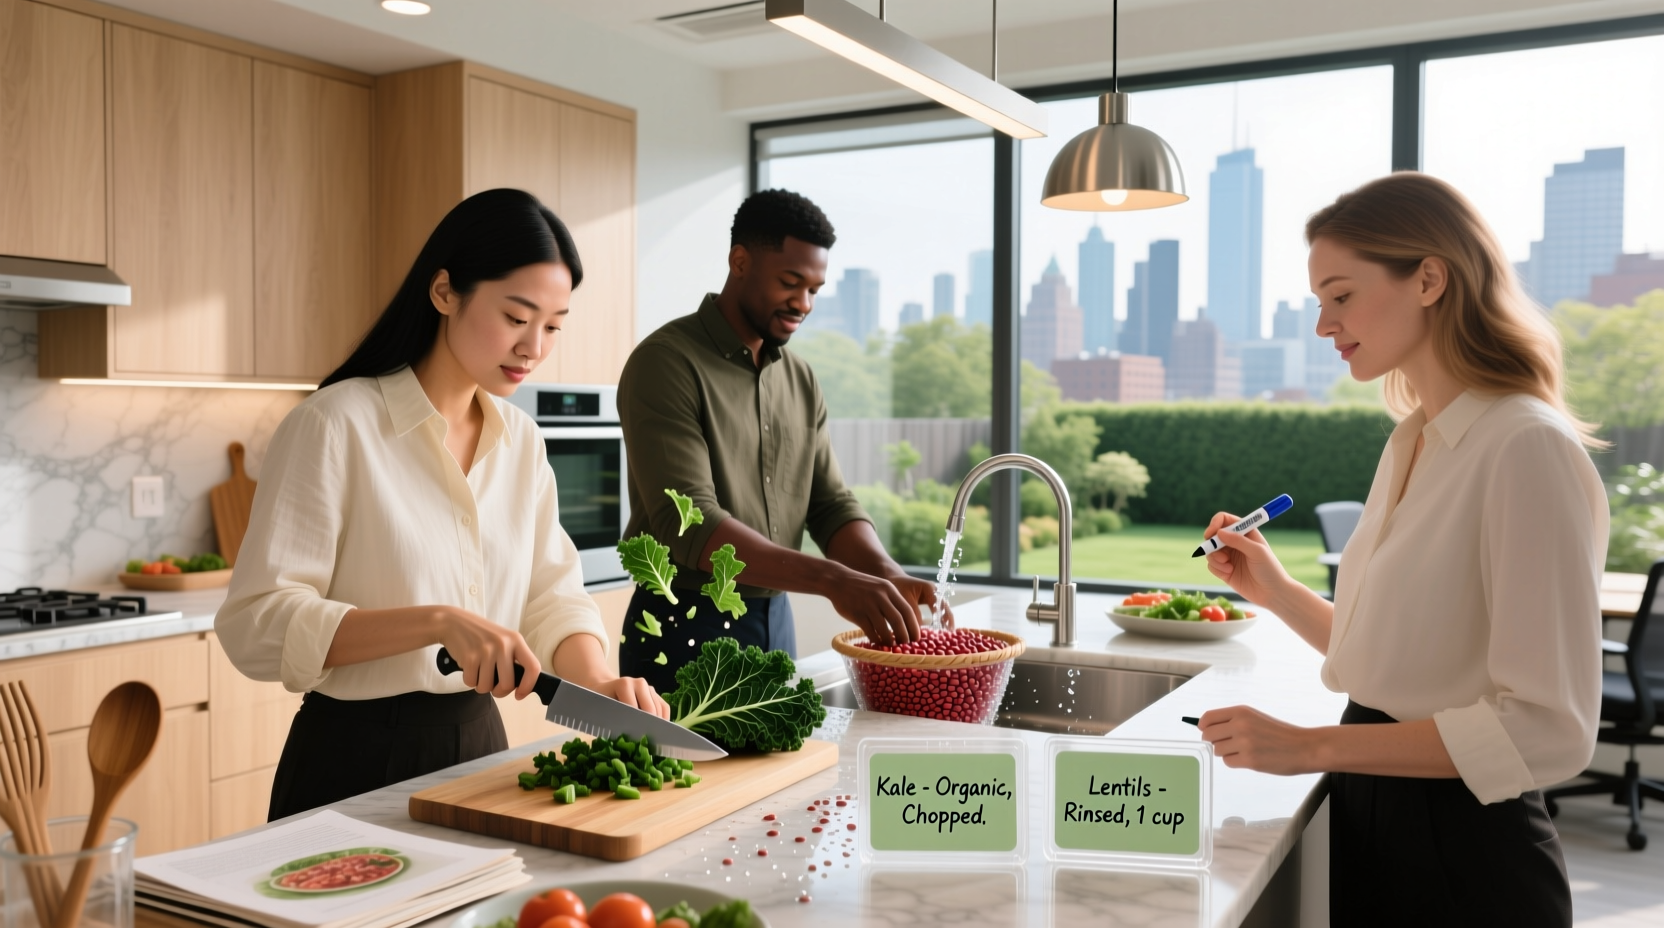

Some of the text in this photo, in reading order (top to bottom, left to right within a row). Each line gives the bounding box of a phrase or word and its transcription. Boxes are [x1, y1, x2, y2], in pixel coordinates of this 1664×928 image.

[876, 774, 917, 797] Kale
[935, 775, 1012, 805] Organic,
[1088, 774, 1152, 798] Lentils
[902, 803, 986, 834] Chopped.
[1064, 801, 1185, 835] Rinsed, 1 cup
